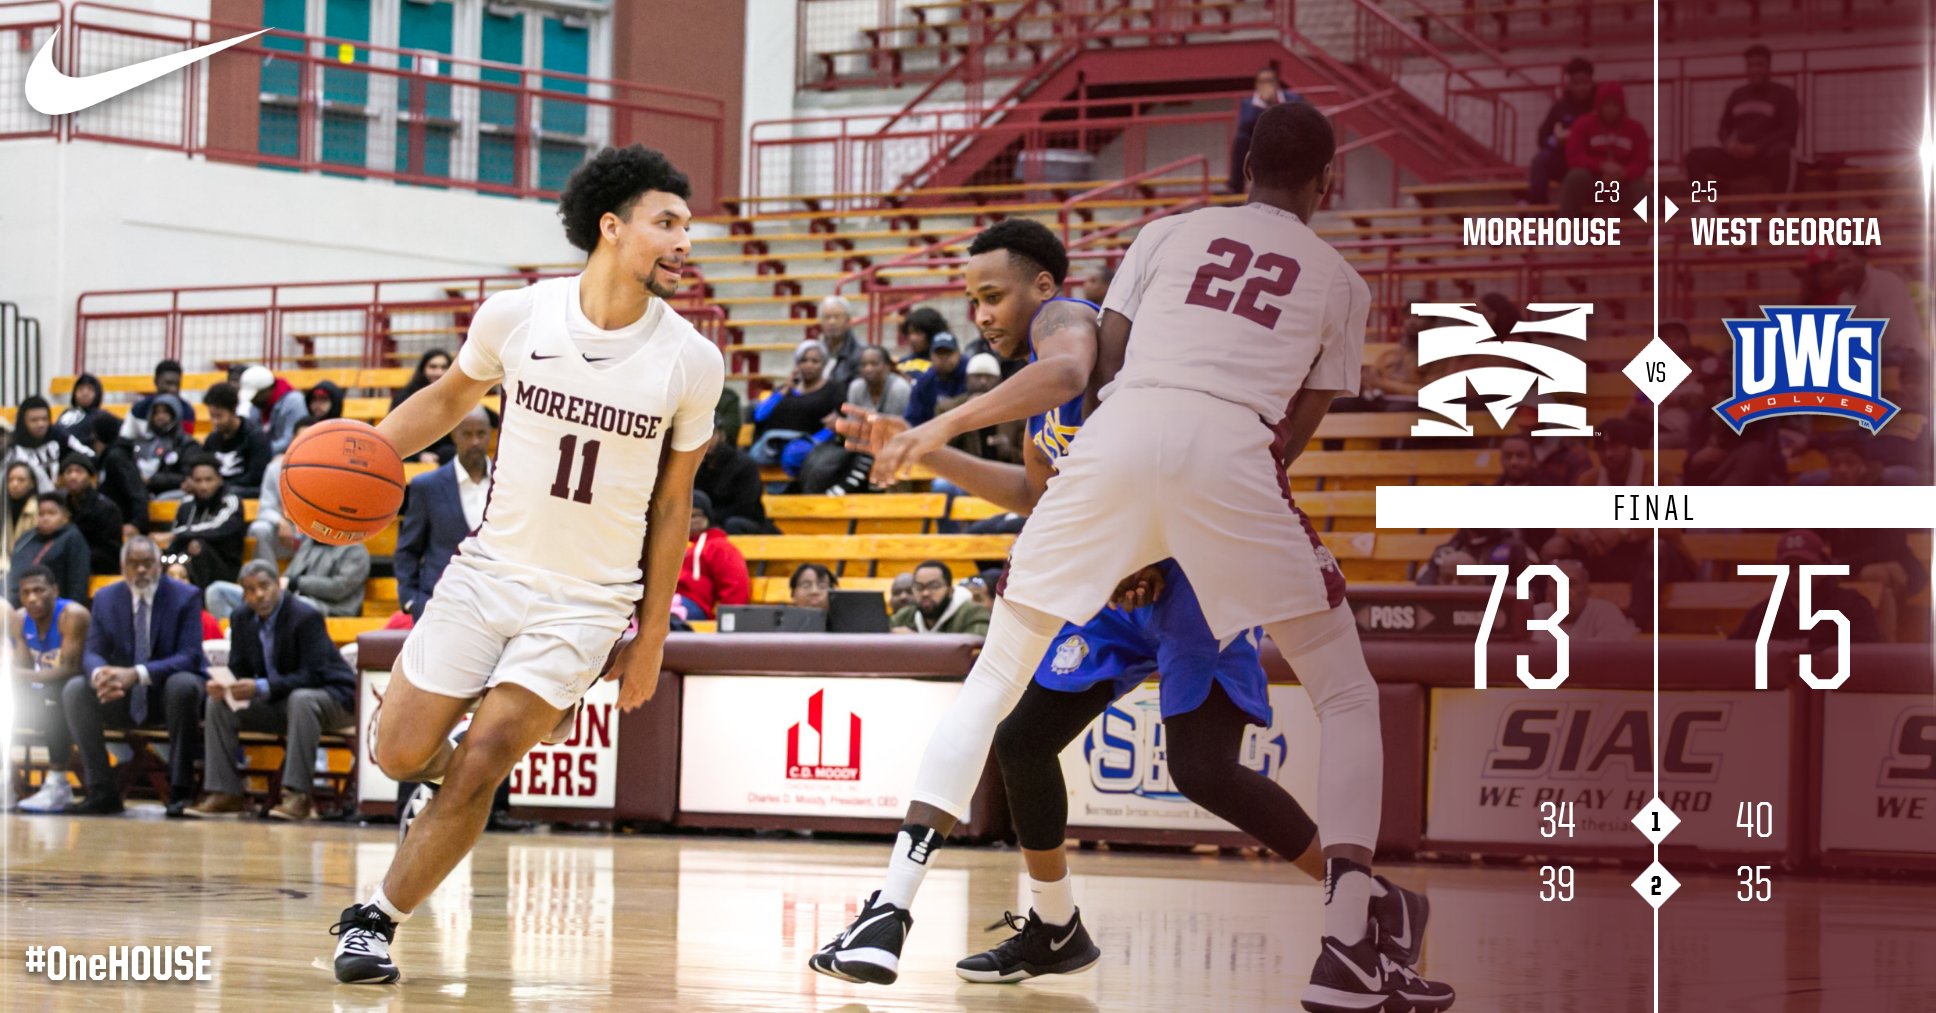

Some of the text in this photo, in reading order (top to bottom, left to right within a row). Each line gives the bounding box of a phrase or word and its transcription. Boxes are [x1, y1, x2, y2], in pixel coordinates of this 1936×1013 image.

[1185, 237, 1301, 330] 22
[516, 380, 662, 440] MOREHOUSE
[550, 434, 600, 505] 11
[1371, 606, 1415, 629] POSS
[1487, 706, 1728, 778] SIAC
[815, 767, 859, 780] MOODY
[1480, 786, 1524, 808] WE
[1533, 786, 1613, 811] PLAY
[1876, 795, 1929, 820] WE
